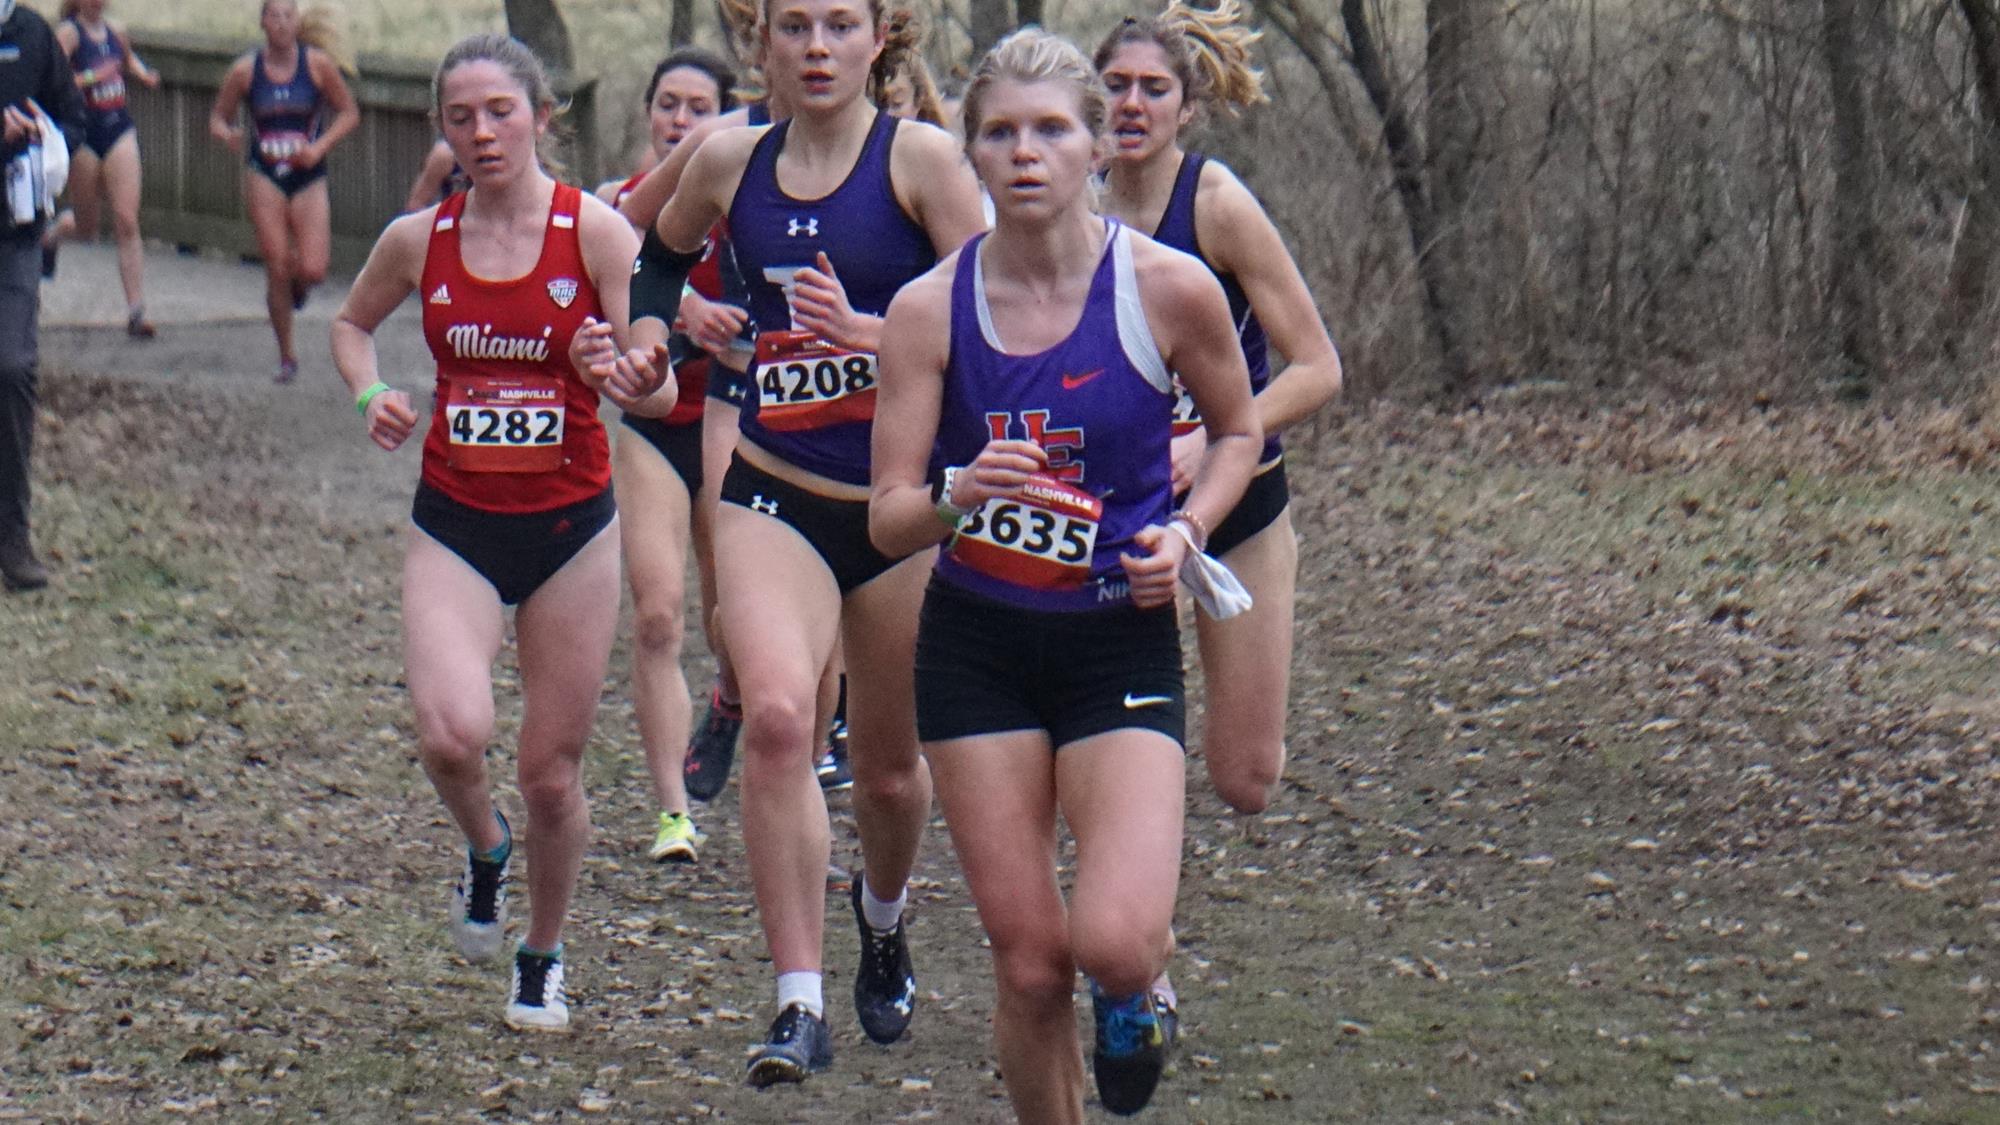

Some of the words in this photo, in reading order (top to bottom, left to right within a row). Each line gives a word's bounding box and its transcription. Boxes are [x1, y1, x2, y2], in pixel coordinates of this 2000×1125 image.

[446, 323, 552, 361] Miami
[500, 389, 556, 400] NASHVILLE
[763, 356, 874, 402] 4208
[453, 409, 559, 444] 4282
[1023, 482, 1094, 511] NASHVILLE
